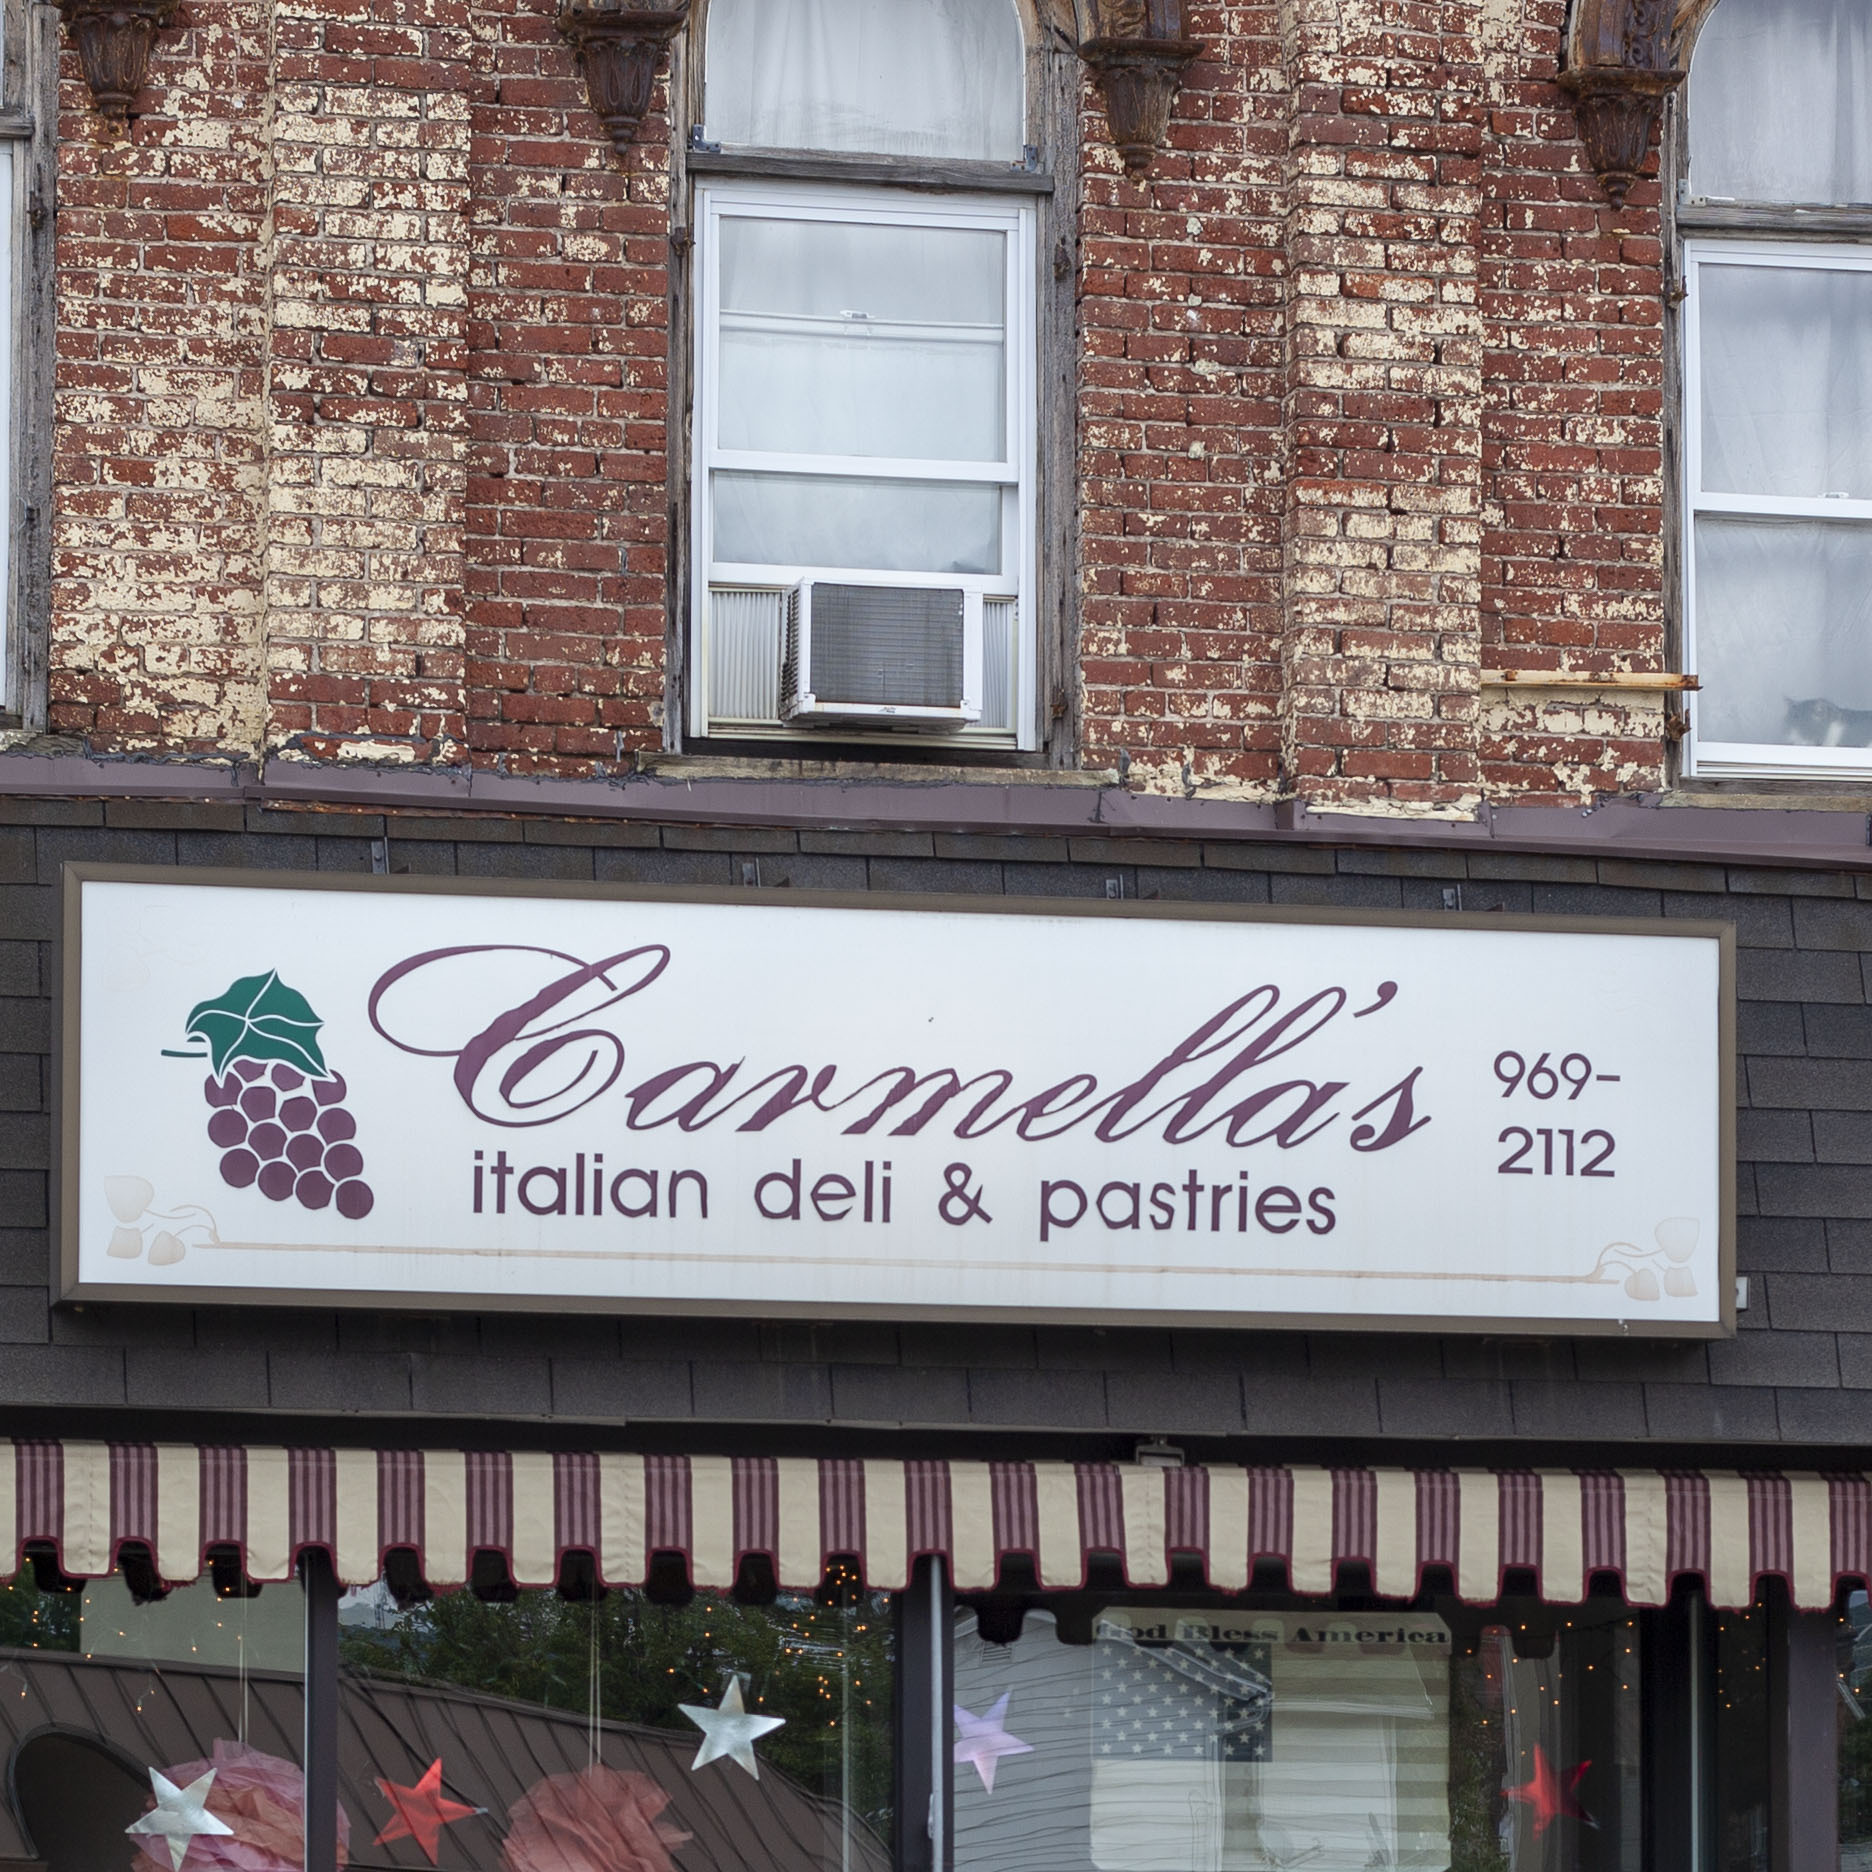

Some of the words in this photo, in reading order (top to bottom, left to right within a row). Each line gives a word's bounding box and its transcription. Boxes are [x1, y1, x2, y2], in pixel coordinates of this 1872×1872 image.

[368, 945, 1431, 1152] Carmella's
[1499, 1128, 1615, 1177] 2112
[473, 1151, 708, 1219] italian
[754, 1159, 891, 1223] deli
[938, 1162, 992, 1225] &
[1040, 1169, 1336, 1241] pastries
[1096, 1622, 1166, 1641] God
[1183, 1622, 1278, 1643] Bless
[1293, 1625, 1450, 1645] America
